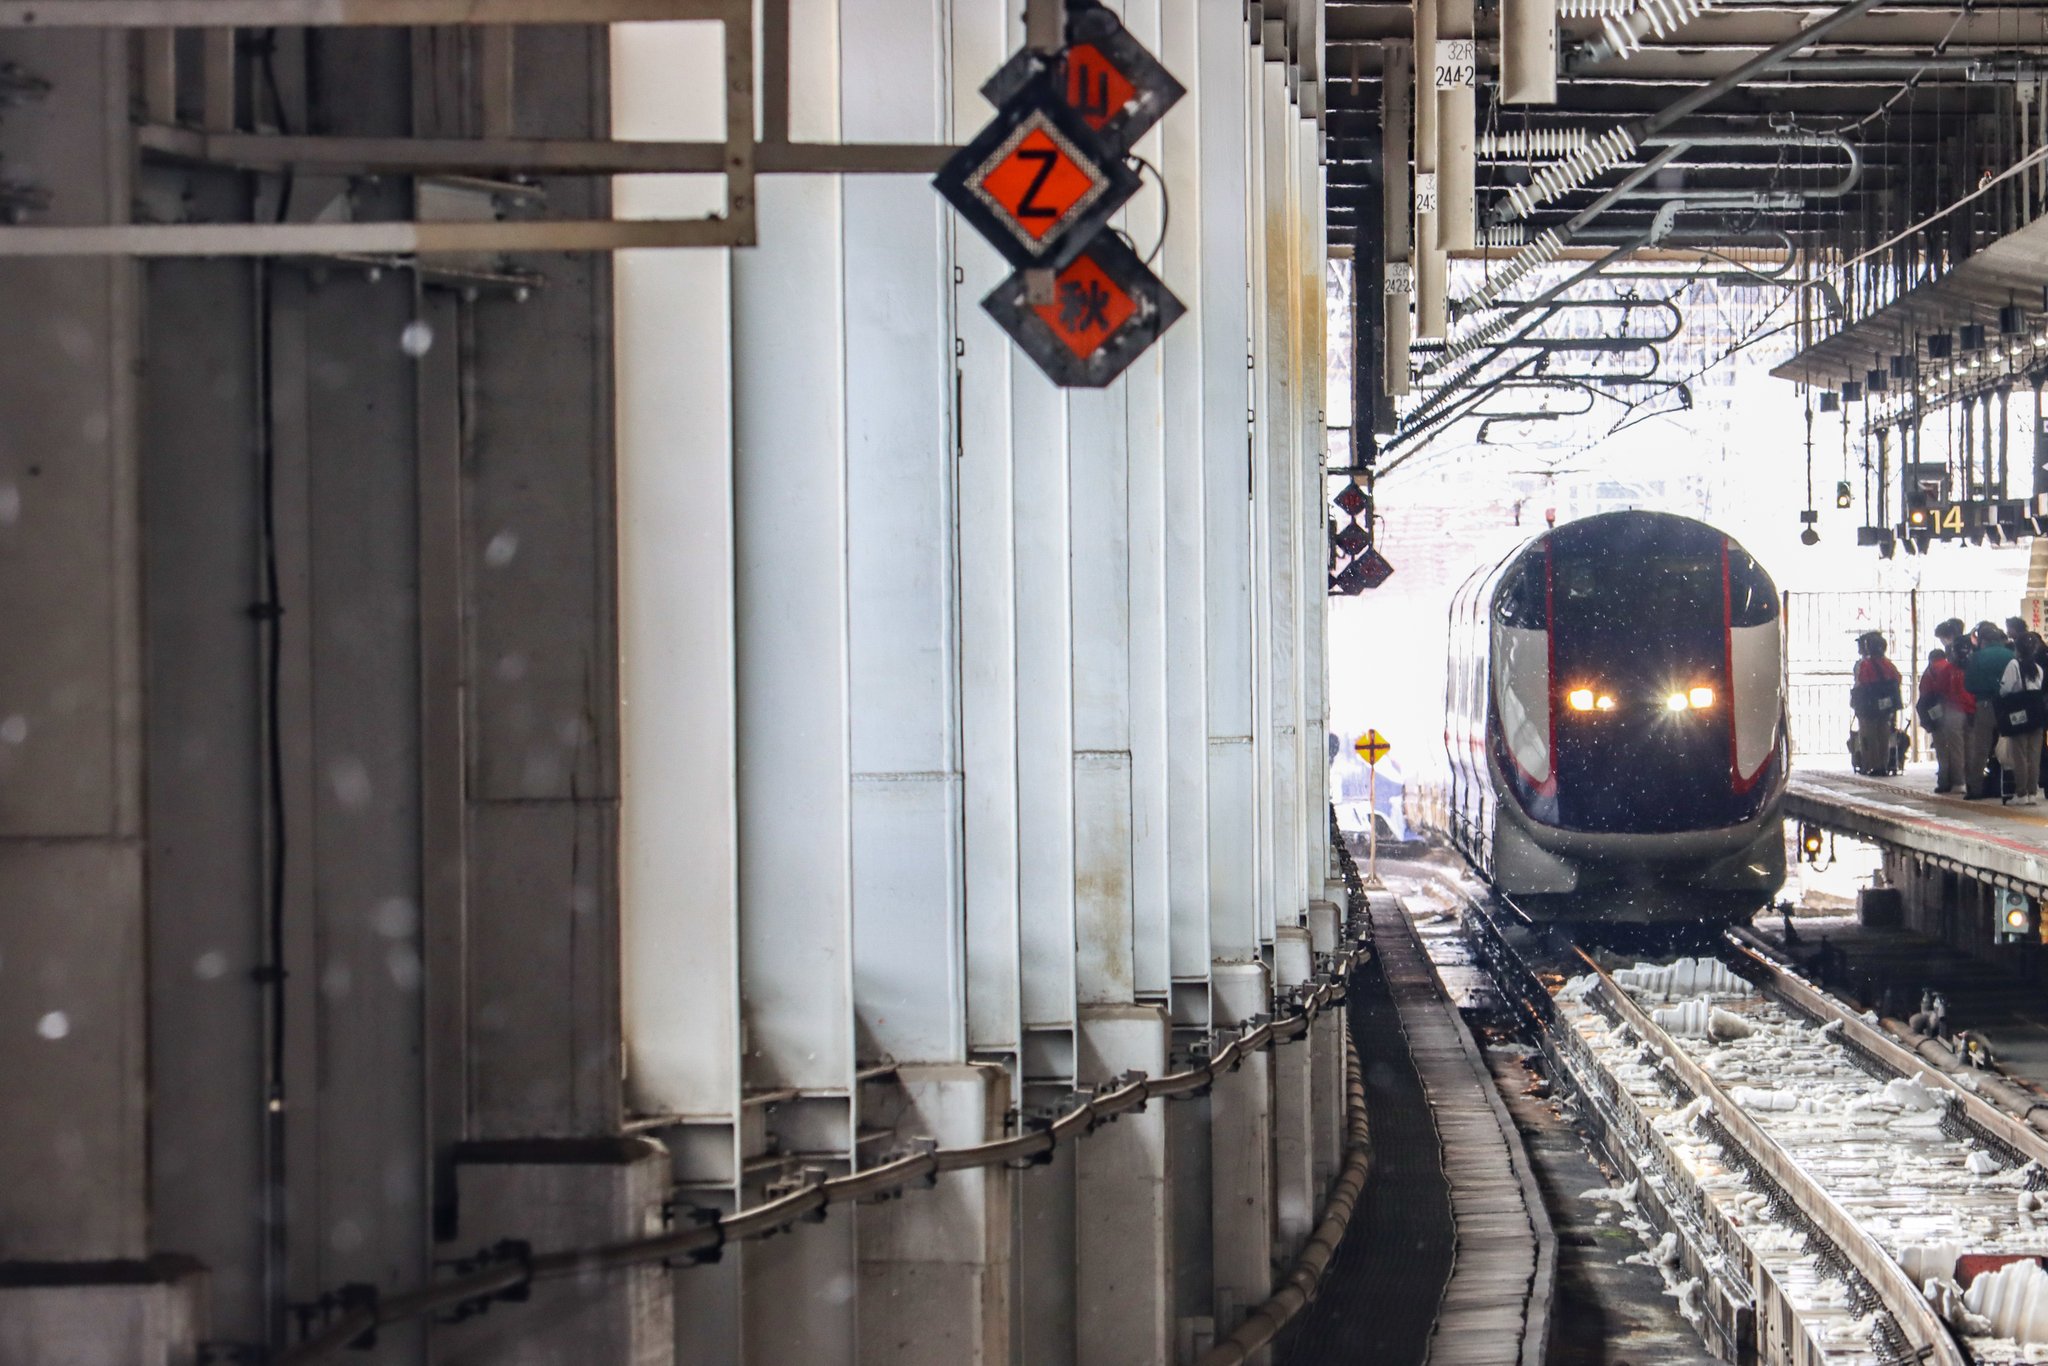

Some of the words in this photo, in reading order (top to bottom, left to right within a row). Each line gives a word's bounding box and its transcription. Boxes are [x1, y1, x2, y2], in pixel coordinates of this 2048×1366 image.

[1435, 65, 1475, 87] 244-2
[1016, 149, 1058, 219] Z
[1058, 279, 1110, 333] 秋
[1928, 505, 1965, 535] 14
